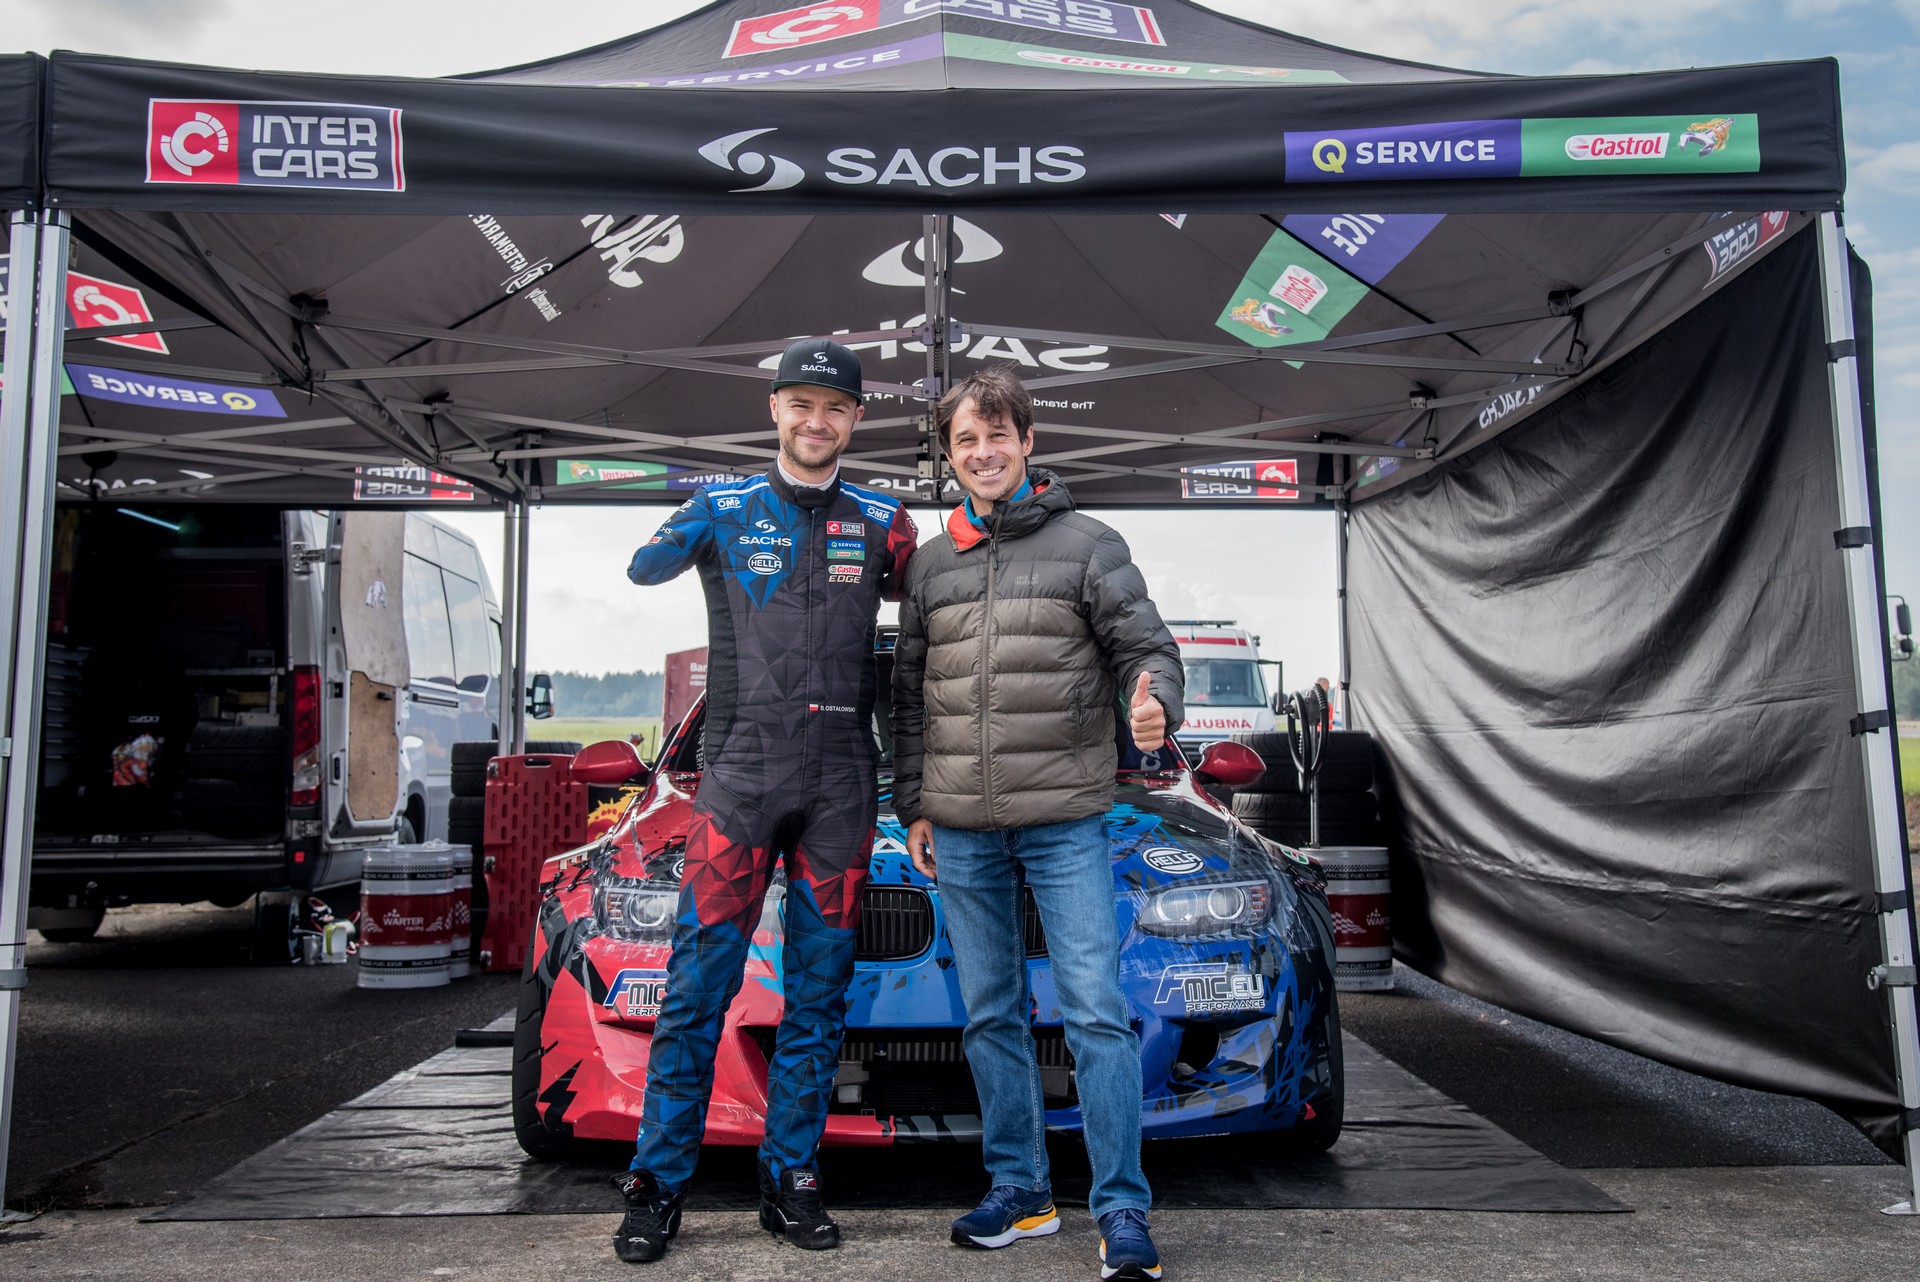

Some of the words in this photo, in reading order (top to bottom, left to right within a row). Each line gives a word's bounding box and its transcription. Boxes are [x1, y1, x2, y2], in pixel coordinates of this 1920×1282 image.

[664, 50, 900, 87] SERVICE
[1060, 57, 1178, 72] Castrol
[253, 115, 377, 146] INTER
[1312, 138, 1347, 173] Q
[1355, 139, 1495, 164] SERVICE
[1590, 136, 1662, 157] Castrol
[253, 149, 379, 180] CARS
[825, 145, 1086, 187] SACHS
[801, 364, 838, 375] SACHS
[717, 498, 741, 509] OMP
[867, 506, 890, 521] OMP
[739, 536, 792, 547] SACHS
[750, 559, 782, 569] HELLA
[836, 566, 861, 575] Castrol
[828, 575, 861, 584] EDGE
[1149, 851, 1203, 868] HELLA
[383, 917, 424, 926] WARTER
[1186, 999, 1265, 1012] PERFORMANCE
